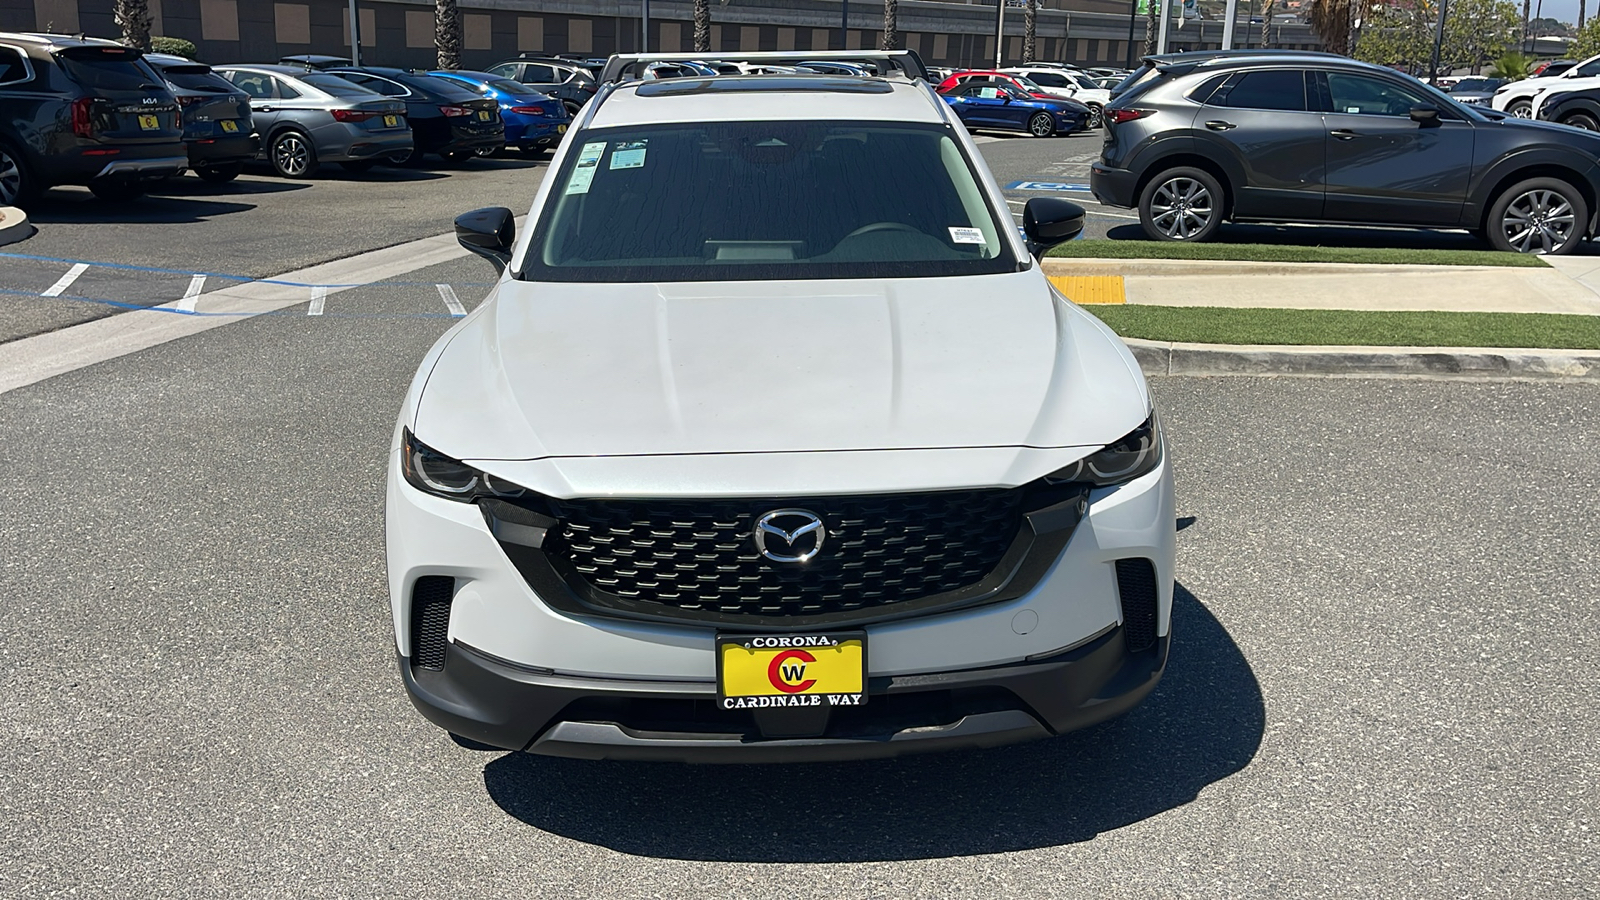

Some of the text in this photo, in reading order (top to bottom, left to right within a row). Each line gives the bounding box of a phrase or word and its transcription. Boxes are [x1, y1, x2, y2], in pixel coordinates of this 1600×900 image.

[752, 636, 830, 648] CORONA
[723, 694, 862, 709] CARDINALE WAY
